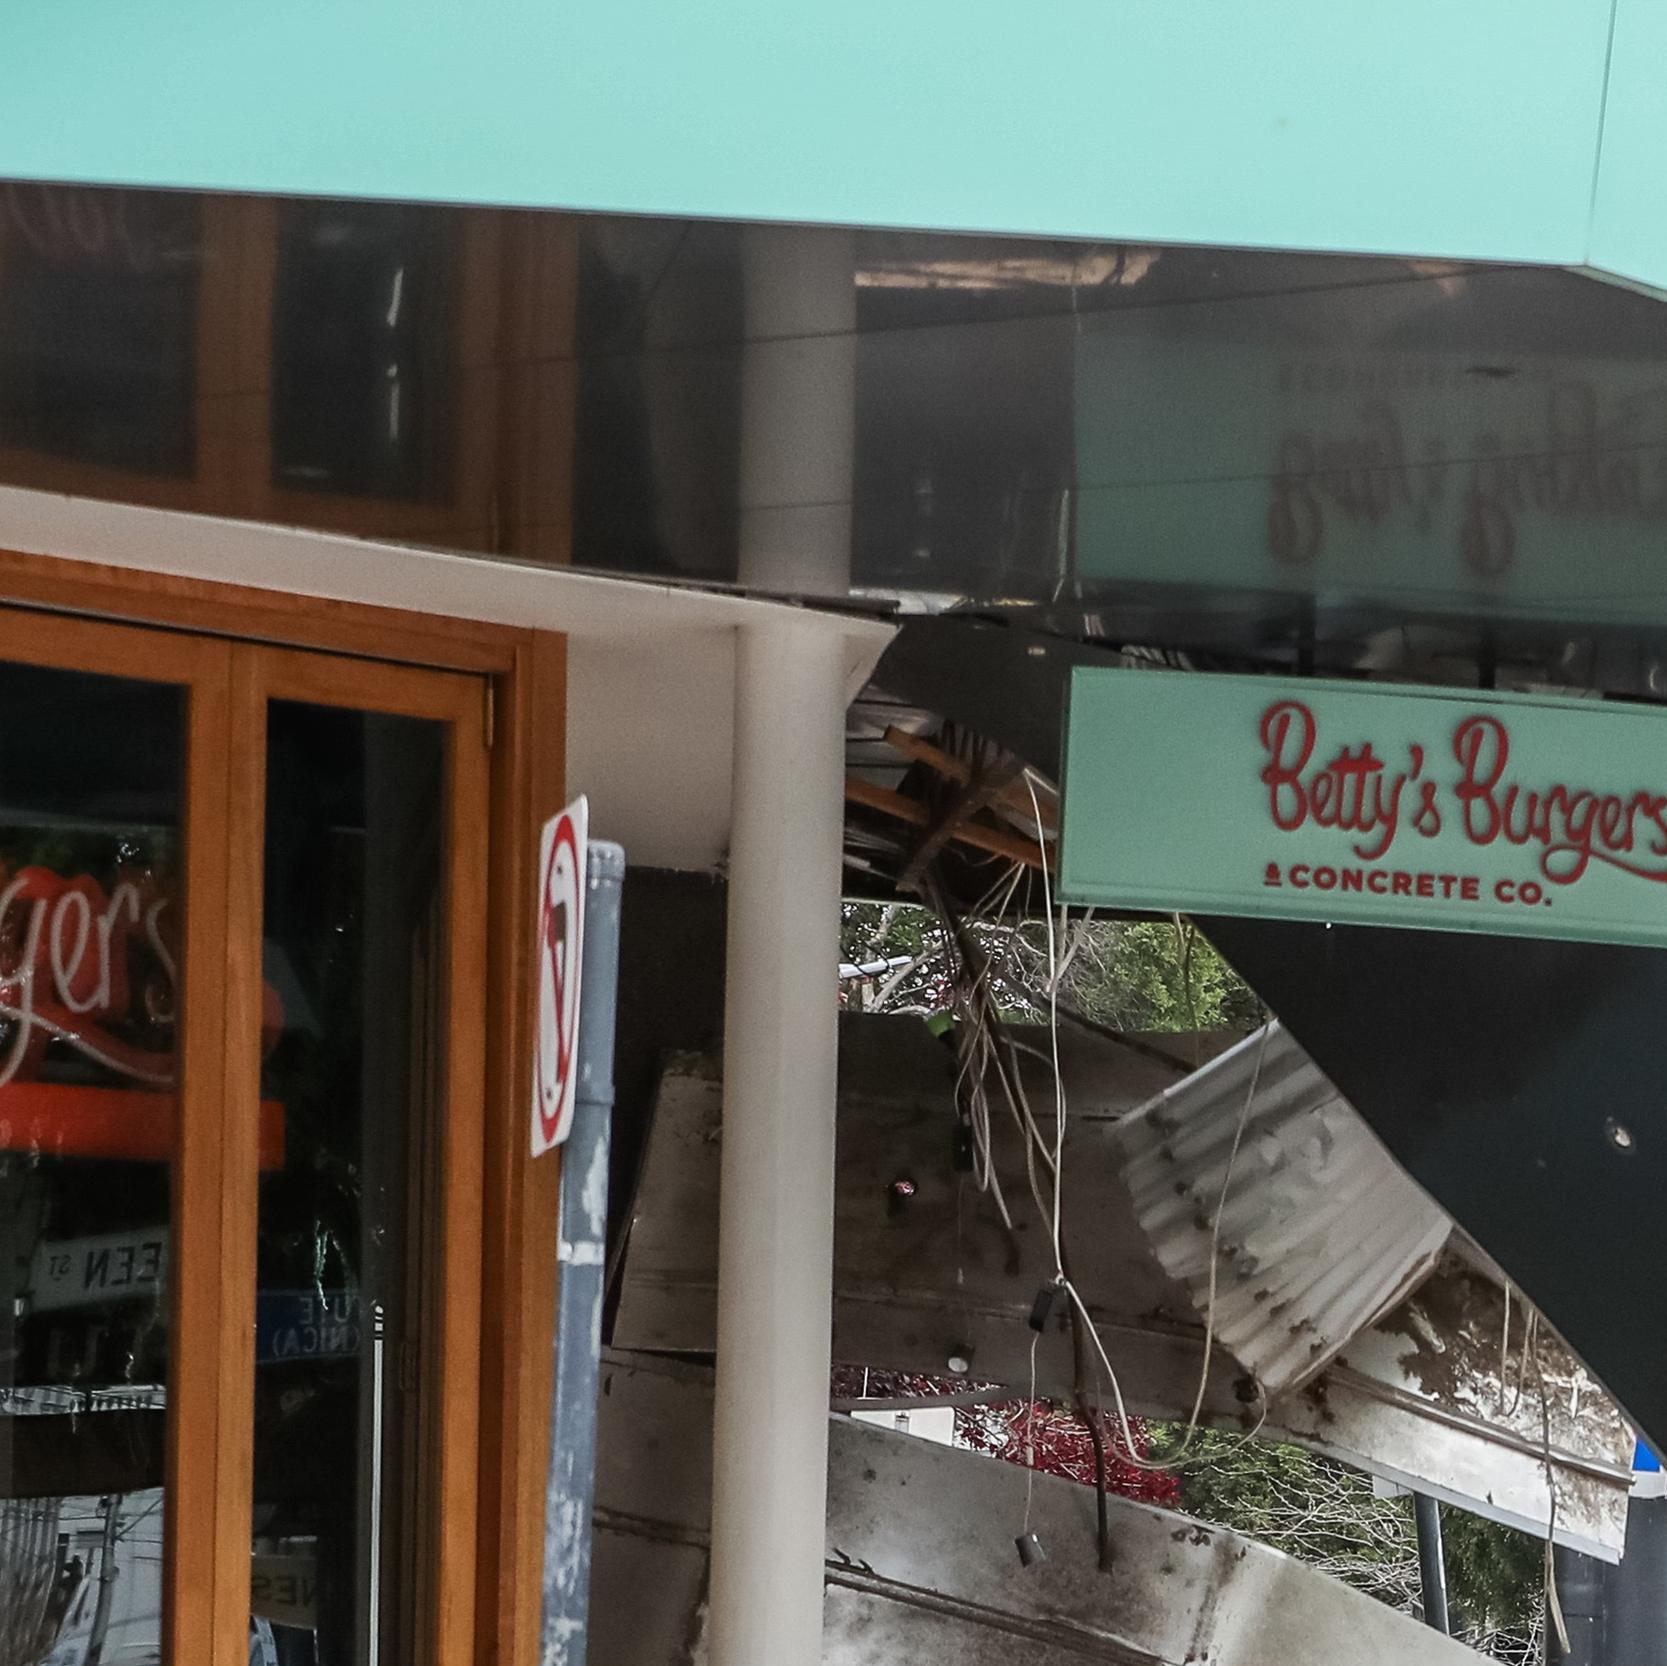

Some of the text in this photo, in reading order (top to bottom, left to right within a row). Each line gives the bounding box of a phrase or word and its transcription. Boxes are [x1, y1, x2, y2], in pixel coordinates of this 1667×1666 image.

[1260, 699, 1440, 861] Betty's
[1288, 863, 1480, 901] CONCRETE
[1493, 878, 1552, 906] CO.
